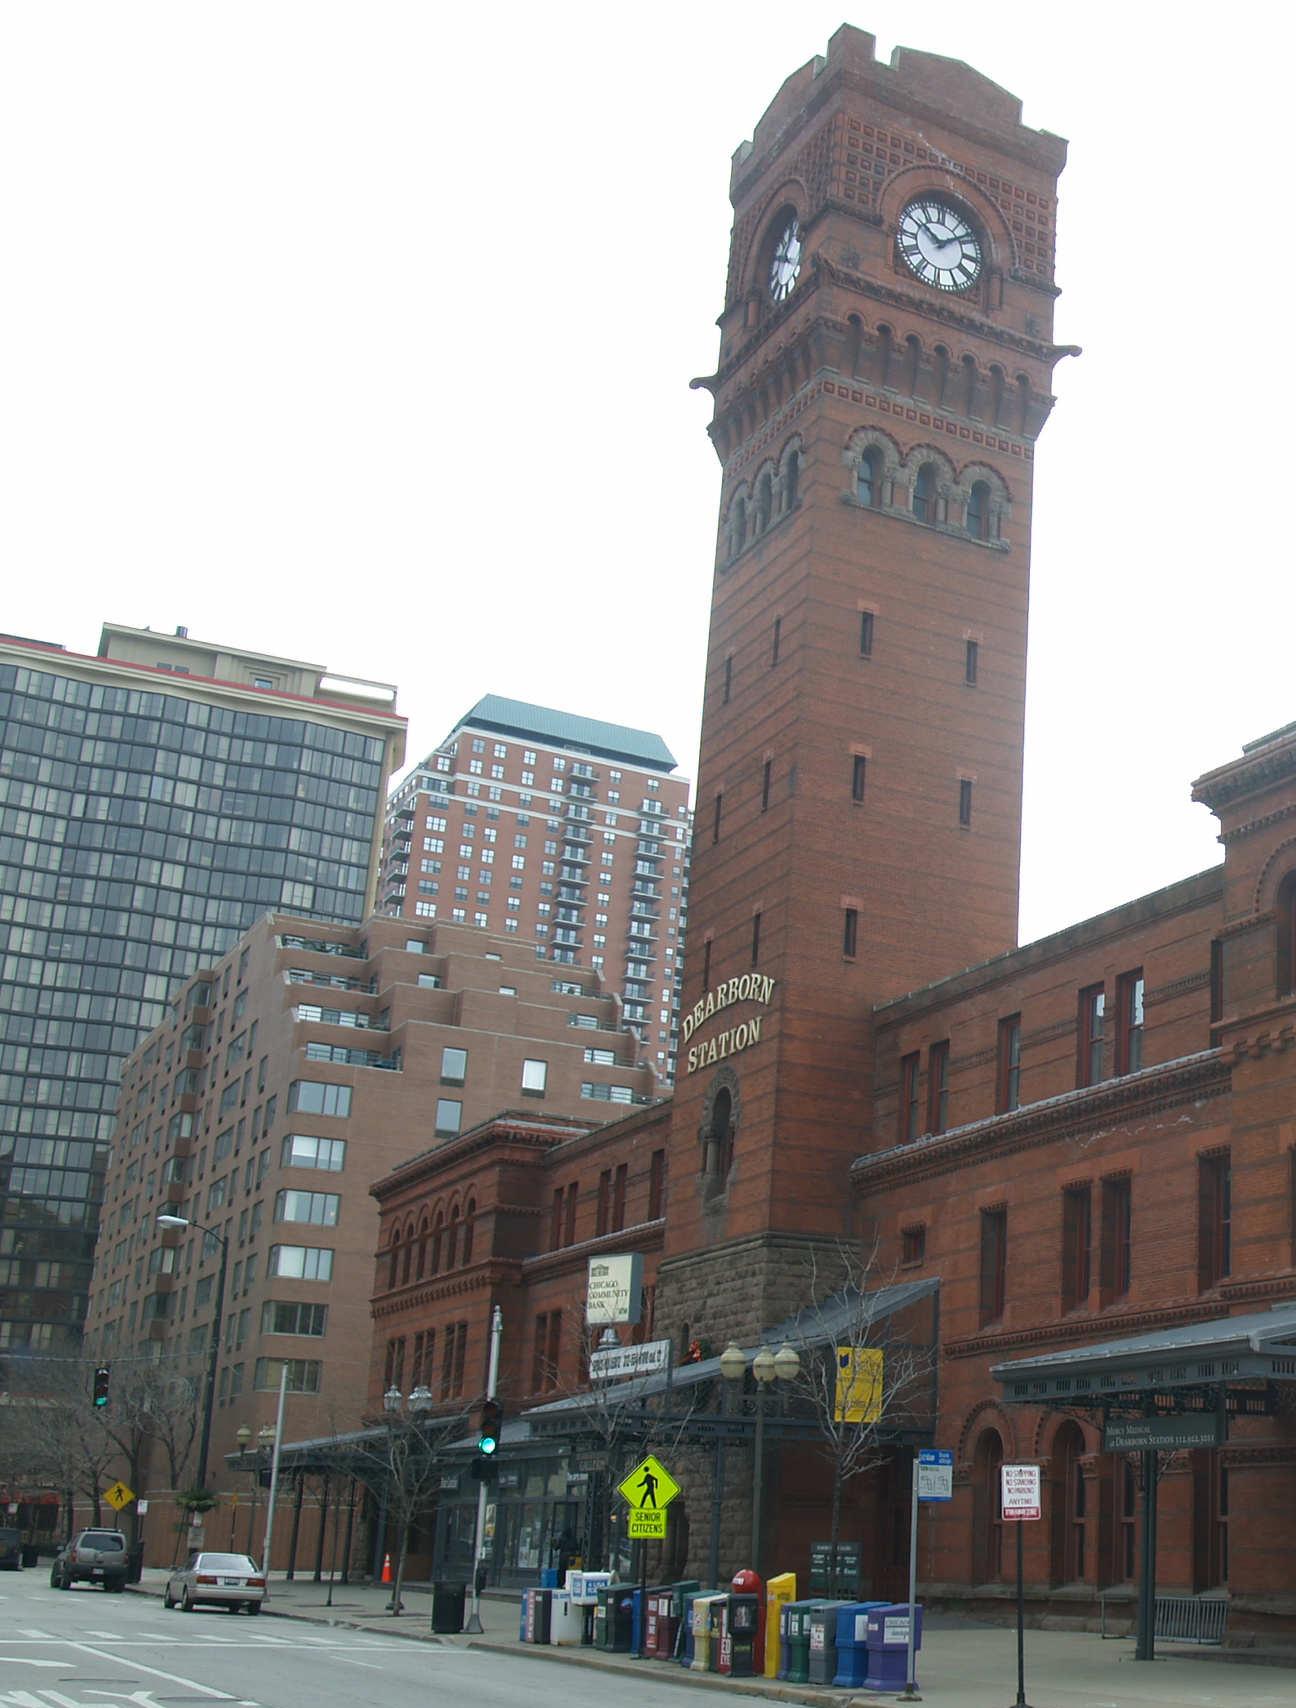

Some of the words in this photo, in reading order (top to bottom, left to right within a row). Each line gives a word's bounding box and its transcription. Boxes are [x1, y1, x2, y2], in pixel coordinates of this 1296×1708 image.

[682, 973, 775, 1042] DEARBORN
[688, 1016, 762, 1073] STATION
[589, 1279, 618, 1290] CHICAGO
[635, 1511, 661, 1521] SENIOR
[631, 1523, 663, 1533] CITIZENS
